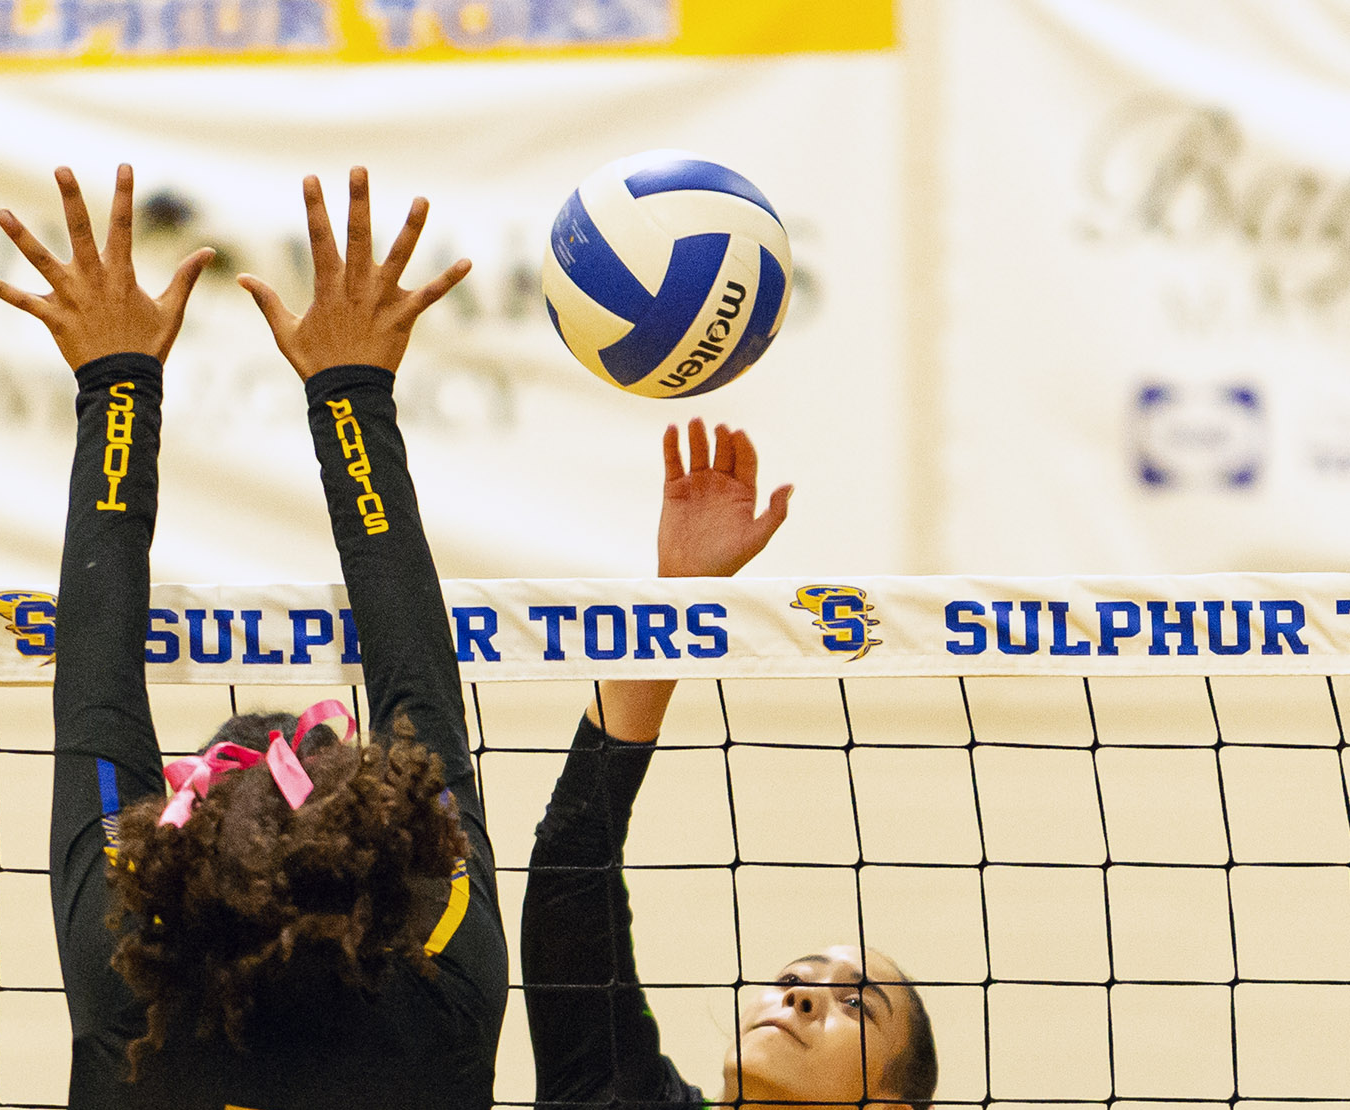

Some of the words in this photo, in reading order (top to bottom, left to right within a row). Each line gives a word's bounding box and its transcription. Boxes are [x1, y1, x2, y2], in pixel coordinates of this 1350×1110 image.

[659, 280, 747, 388] molten
[146, 606, 501, 664] SULPR
[529, 603, 729, 660] TORS
[944, 600, 1310, 656] SULPHUR
